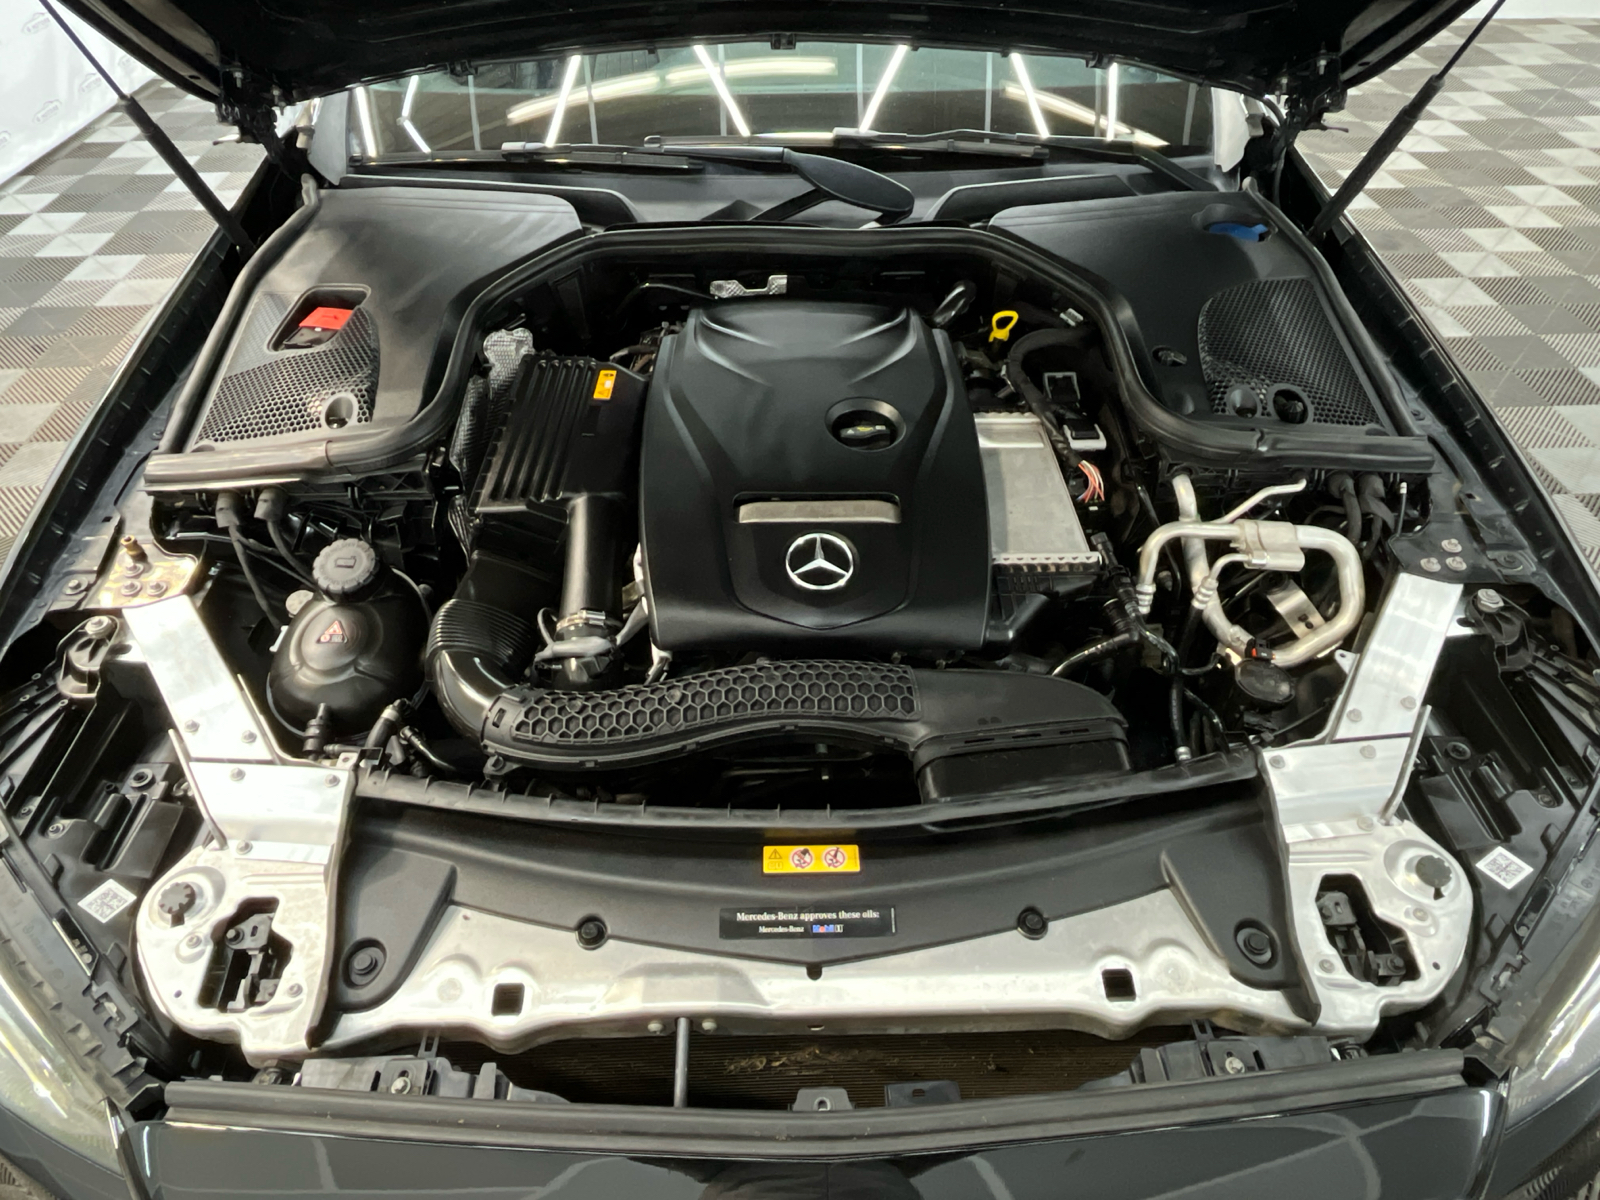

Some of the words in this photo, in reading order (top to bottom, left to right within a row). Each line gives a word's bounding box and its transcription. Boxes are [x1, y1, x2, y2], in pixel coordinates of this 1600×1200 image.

[736, 912, 798, 921] Mercedes-Benz
[800, 912, 837, 921] approves
[838, 910, 861, 919] these
[759, 925, 804, 933] Mercedes-Benz
